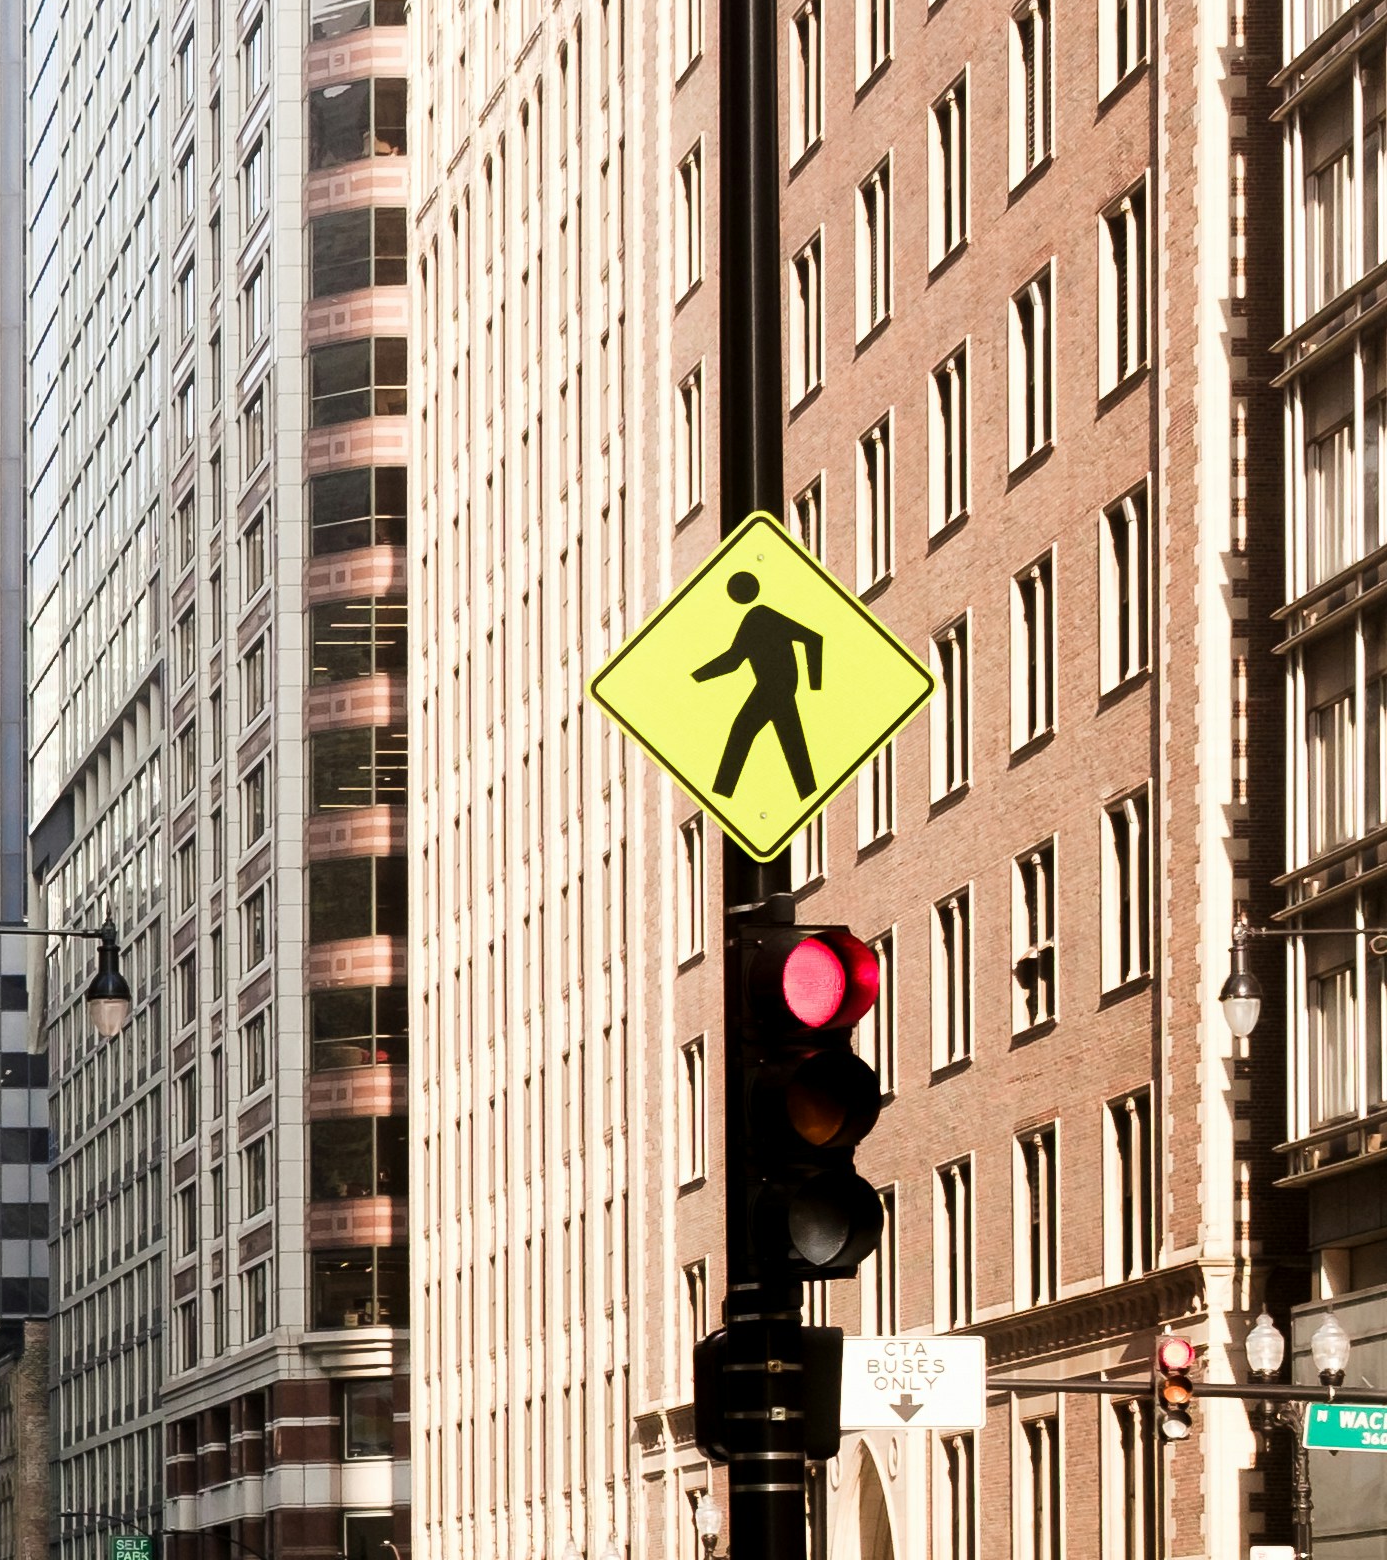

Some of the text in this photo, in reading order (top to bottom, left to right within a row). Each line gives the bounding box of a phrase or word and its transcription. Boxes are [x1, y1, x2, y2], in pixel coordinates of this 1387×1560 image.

[884, 1342, 927, 1356] CTA
[867, 1359, 945, 1373] BUSES
[874, 1376, 938, 1390] ONLY
[1317, 1409, 1328, 1422] N
[116, 1539, 148, 1551] SELF
